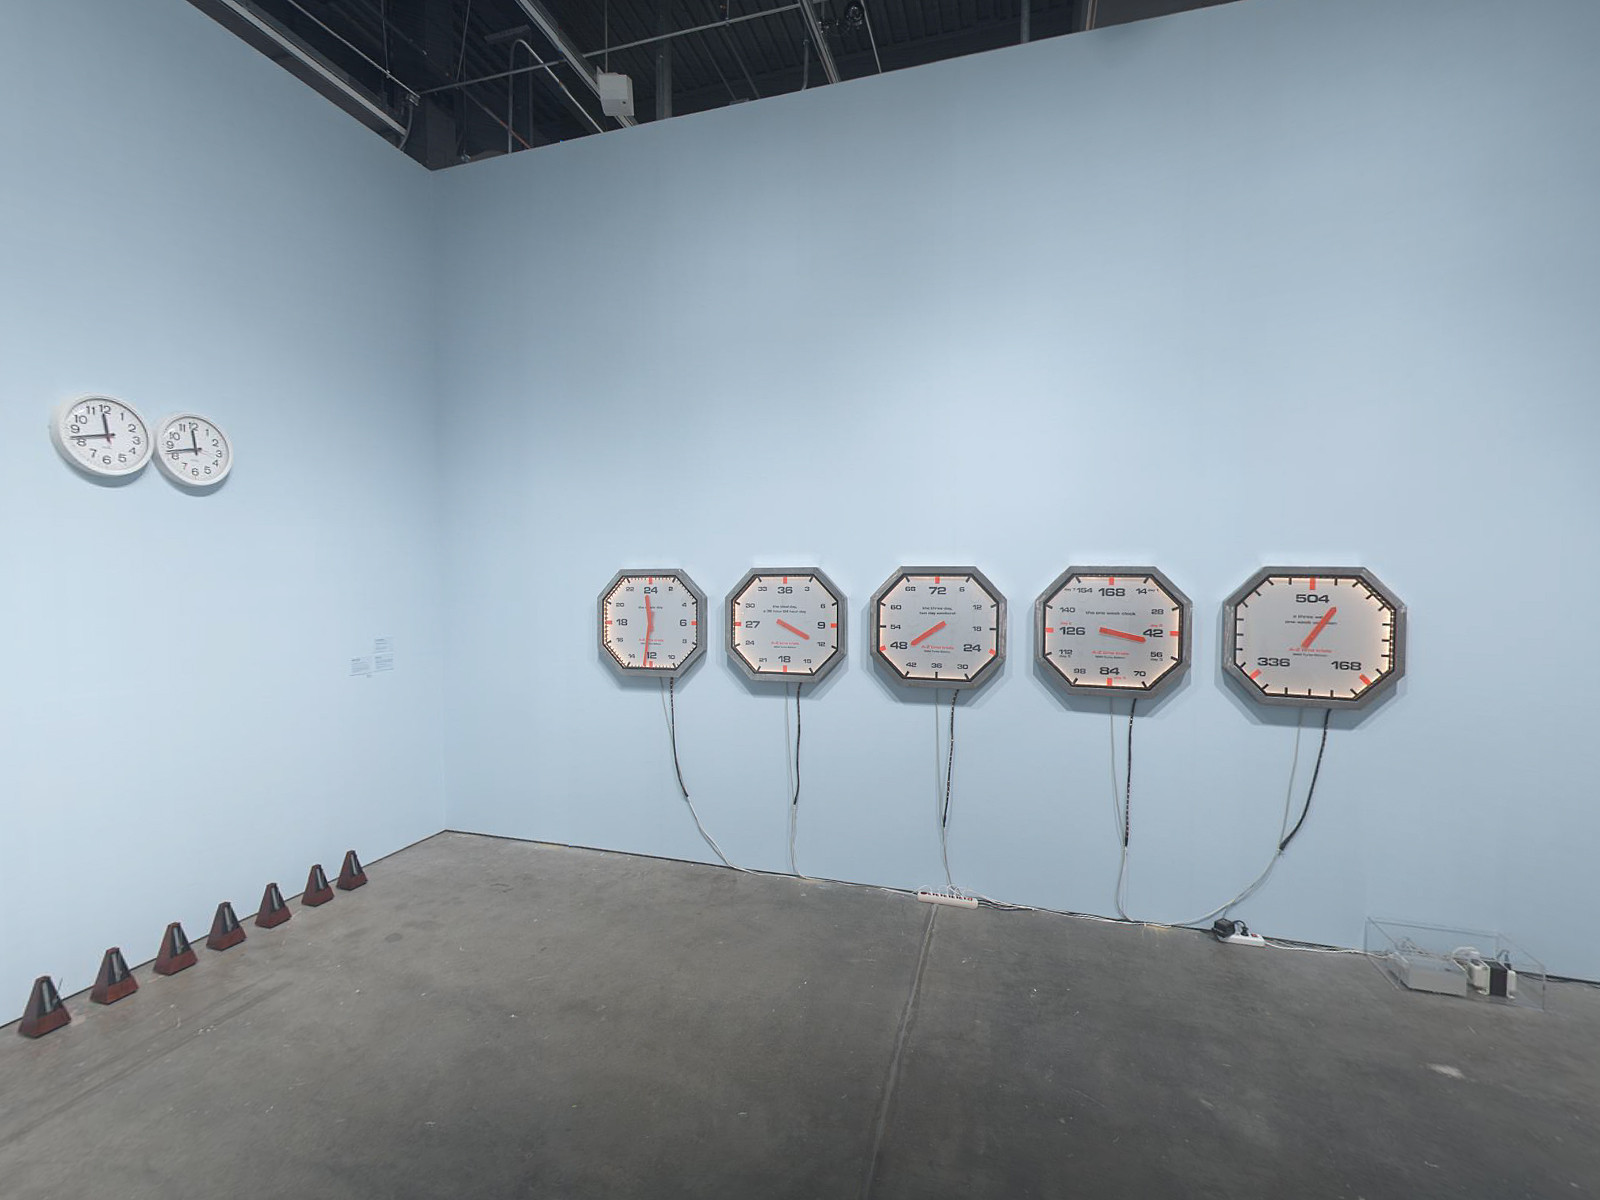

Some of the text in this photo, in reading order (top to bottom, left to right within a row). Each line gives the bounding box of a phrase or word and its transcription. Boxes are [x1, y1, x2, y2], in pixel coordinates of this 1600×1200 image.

[86, 406, 96, 415] 11
[98, 404, 111, 414] 12
[74, 414, 88, 424] 10
[120, 412, 124, 421] 1
[70, 424, 80, 434] 9
[128, 423, 136, 433] 2
[179, 423, 186, 432] 11
[189, 422, 199, 431] 12
[132, 436, 141, 445] 3
[169, 432, 180, 440] 10
[166, 441, 174, 449] 9
[212, 439, 219, 447] 2
[89, 448, 97, 458] 7
[118, 453, 127, 462] 5
[216, 450, 222, 458] 3
[102, 455, 112, 464] 6
[182, 462, 188, 470] 7
[204, 466, 211, 474] 5
[192, 468, 199, 476] 6
[777, 586, 793, 594] 36
[1098, 588, 1125, 597] 168
[1296, 595, 1330, 603] 504
[1059, 627, 1085, 635] 126
[1143, 629, 1163, 638] 42
[890, 641, 908, 650] 48
[963, 644, 981, 652] 24
[1257, 658, 1290, 667] 336
[1331, 661, 1361, 671] 168
[1100, 667, 1120, 675] 84
